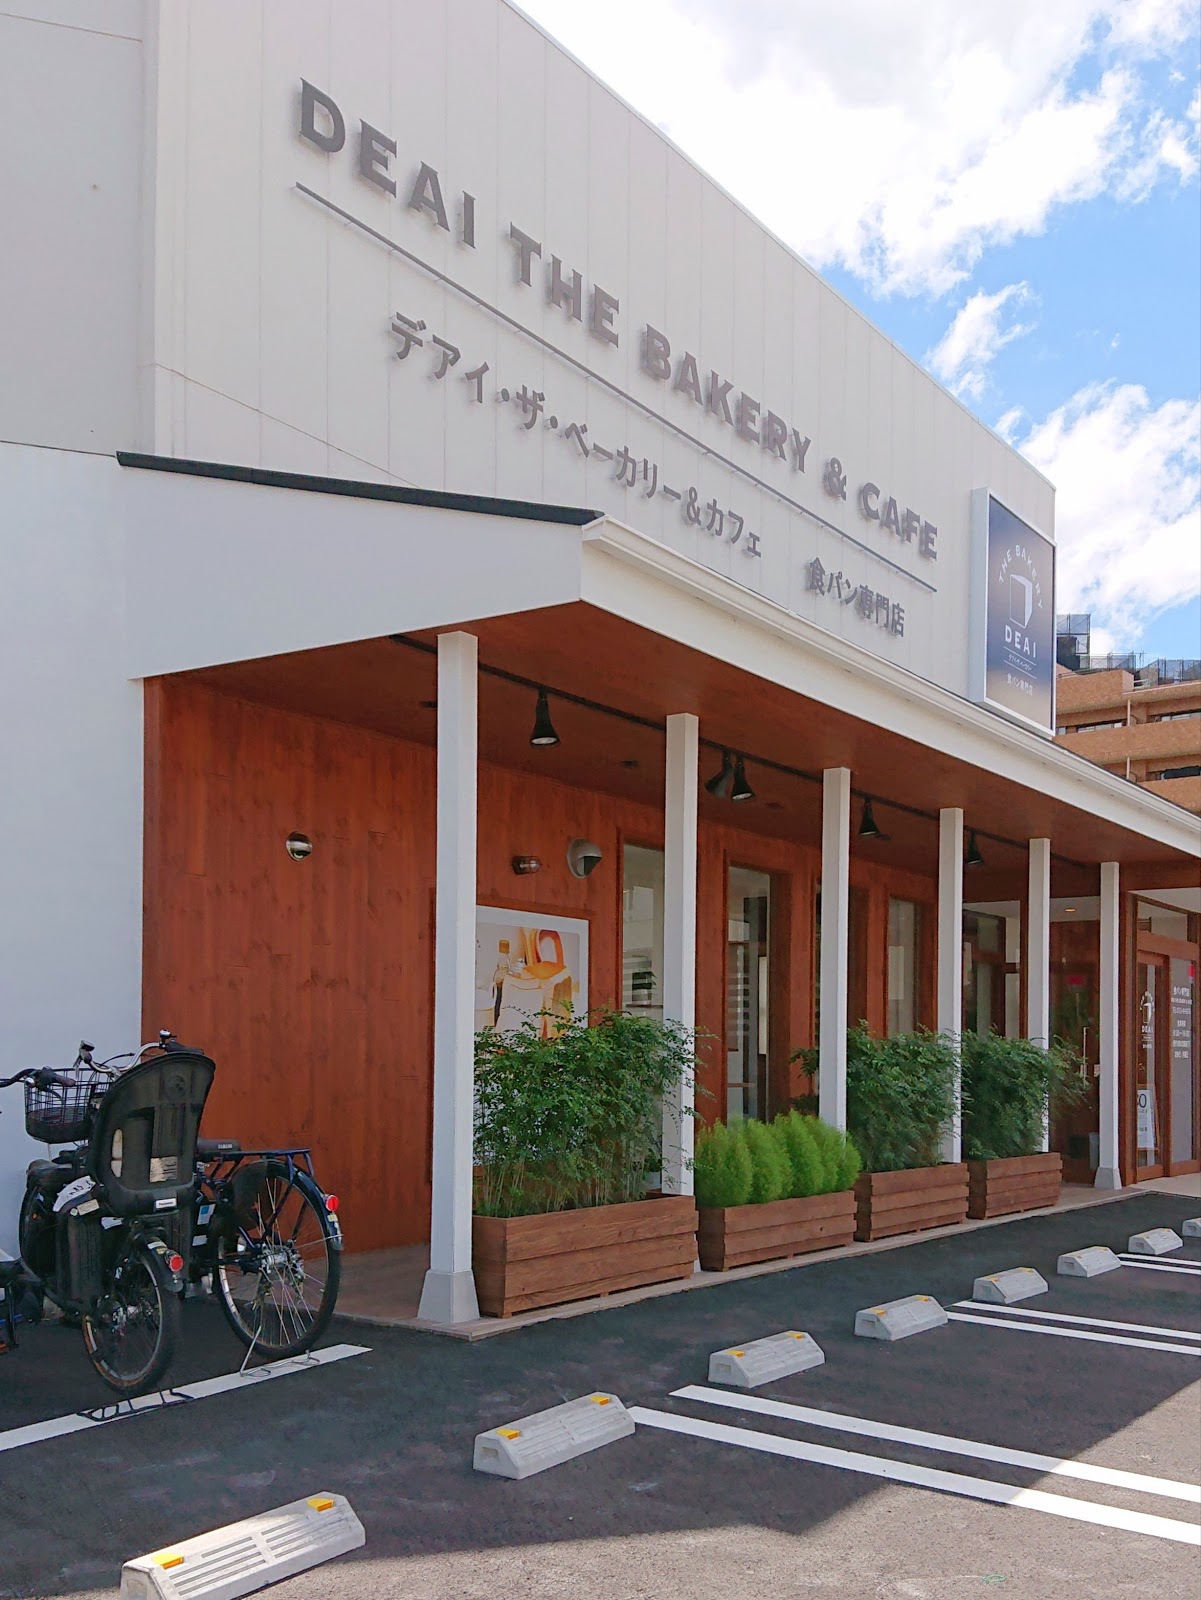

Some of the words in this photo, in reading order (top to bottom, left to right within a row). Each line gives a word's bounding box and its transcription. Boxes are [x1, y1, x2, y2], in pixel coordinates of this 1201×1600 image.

[300, 77, 475, 248] DEAI
[511, 222, 619, 348] THE
[645, 323, 811, 473] BAKERY
[825, 457, 847, 501] &
[863, 482, 938, 559] CAFE
[808, 557, 904, 637] 食パン専門店
[999, 549, 1012, 582] THE
[1015, 545, 1043, 608] BAKERY
[1004, 624, 1036, 658] DEAI
